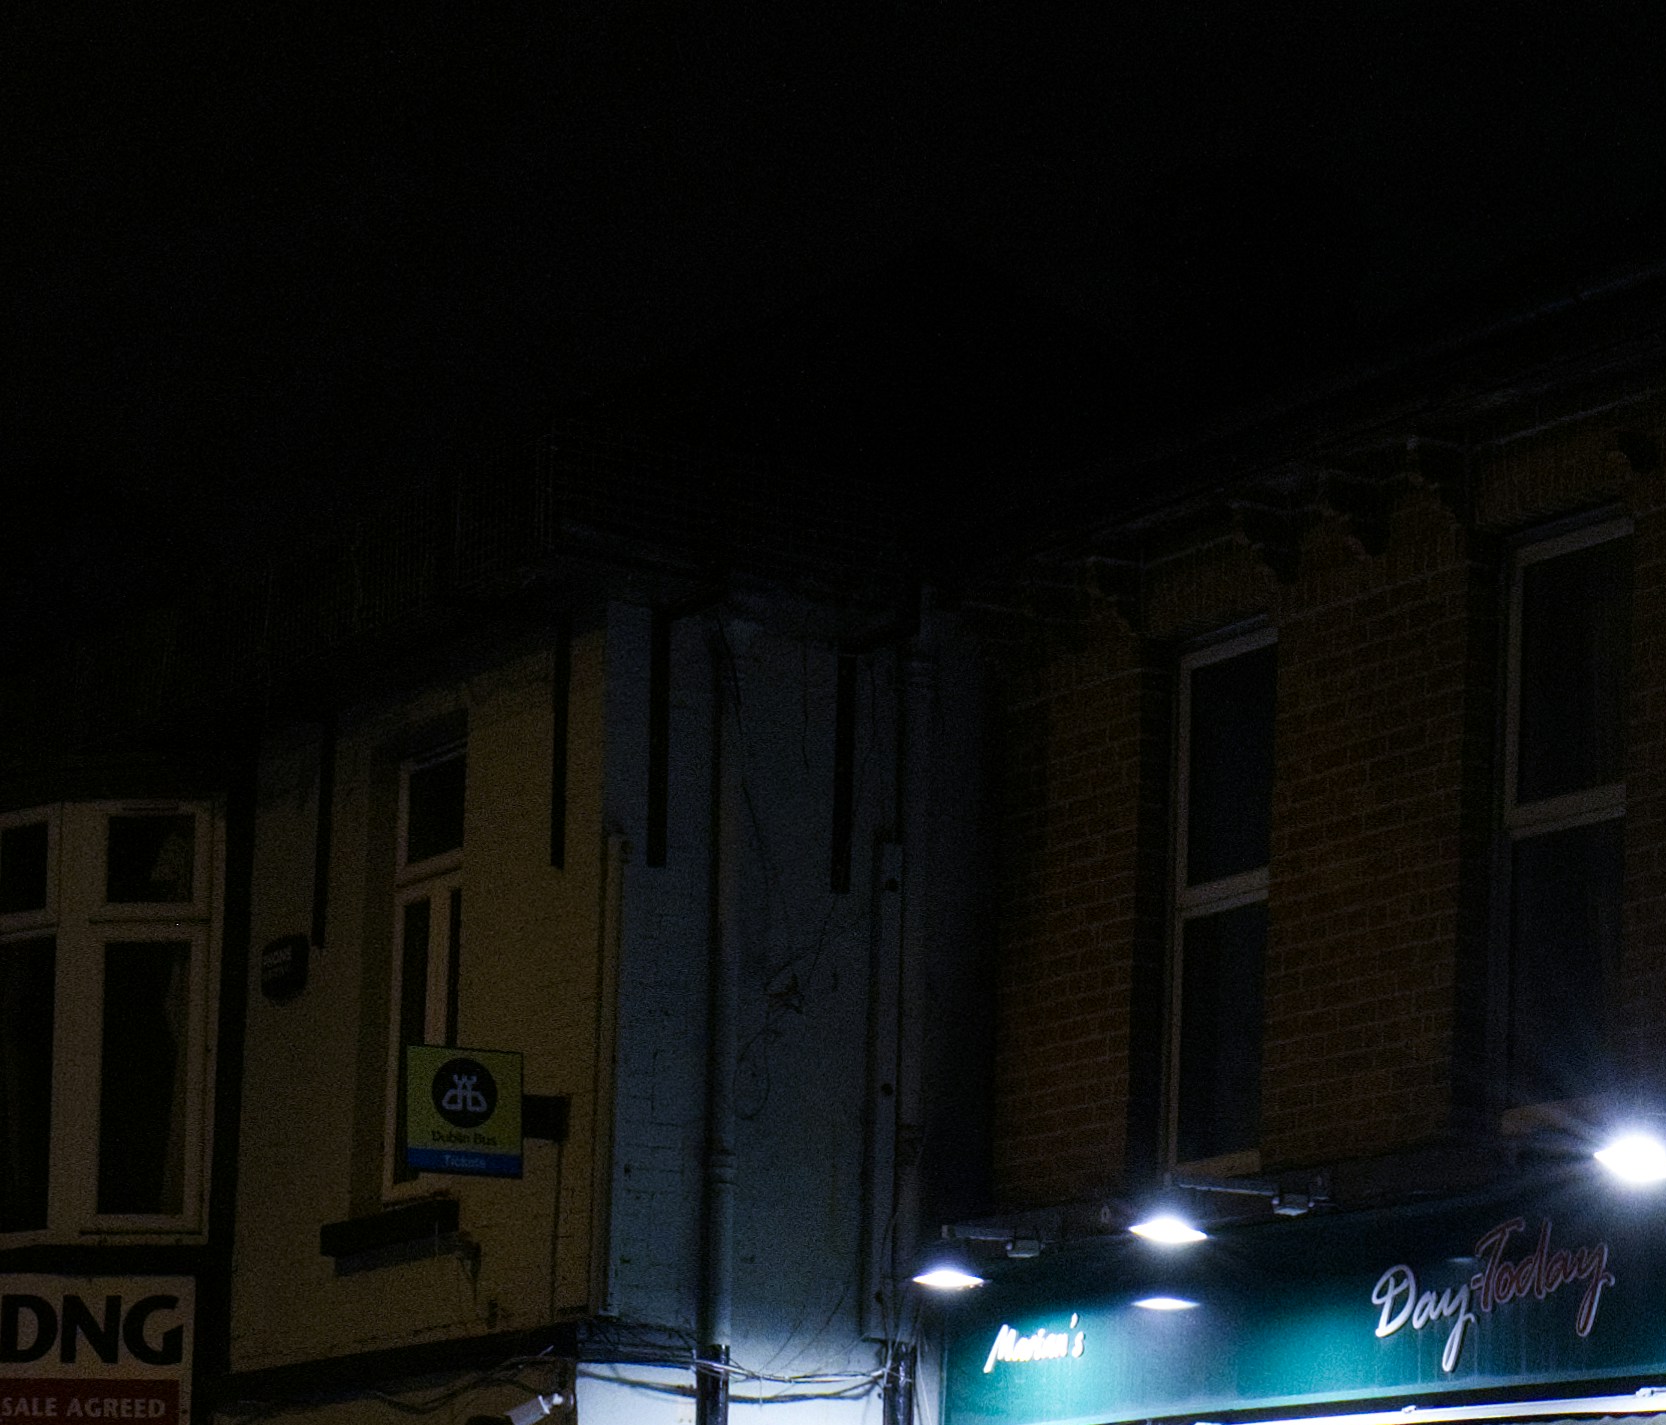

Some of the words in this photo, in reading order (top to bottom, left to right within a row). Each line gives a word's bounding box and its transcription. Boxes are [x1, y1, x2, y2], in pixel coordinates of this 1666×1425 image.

[473, 1132, 498, 1146] Bus
[0, 1293, 184, 1366] DNG
[0, 1397, 57, 1420] SALE
[65, 1396, 167, 1420] AGREED
